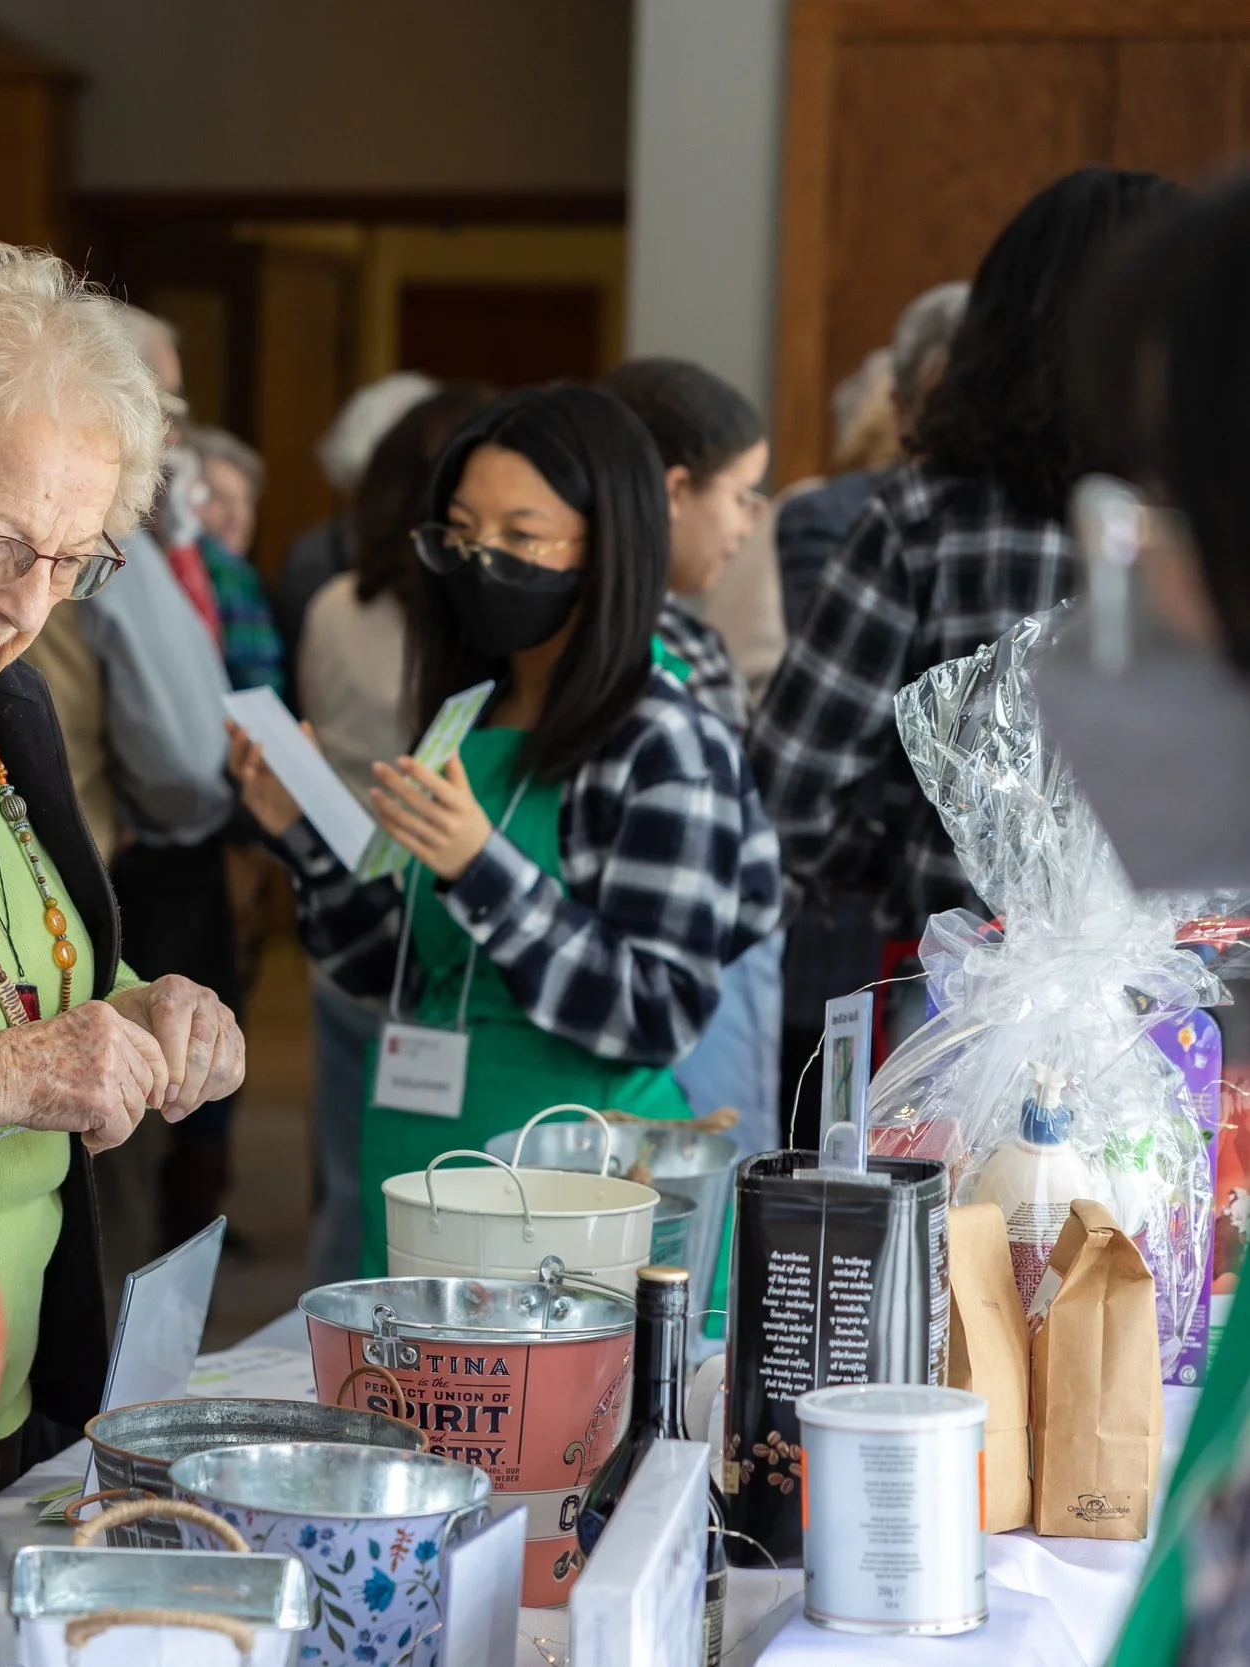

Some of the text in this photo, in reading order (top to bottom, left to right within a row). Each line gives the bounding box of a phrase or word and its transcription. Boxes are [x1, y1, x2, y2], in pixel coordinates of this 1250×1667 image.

[786, 1264, 795, 1275] of
[768, 1274, 777, 1285] of
[777, 1275, 787, 1284] the
[417, 1377, 450, 1388] is the
[434, 1390, 484, 1402] UNION
[491, 1393, 511, 1403] OF
[429, 1432, 446, 1444] nd
[505, 1467, 520, 1475] OUR
